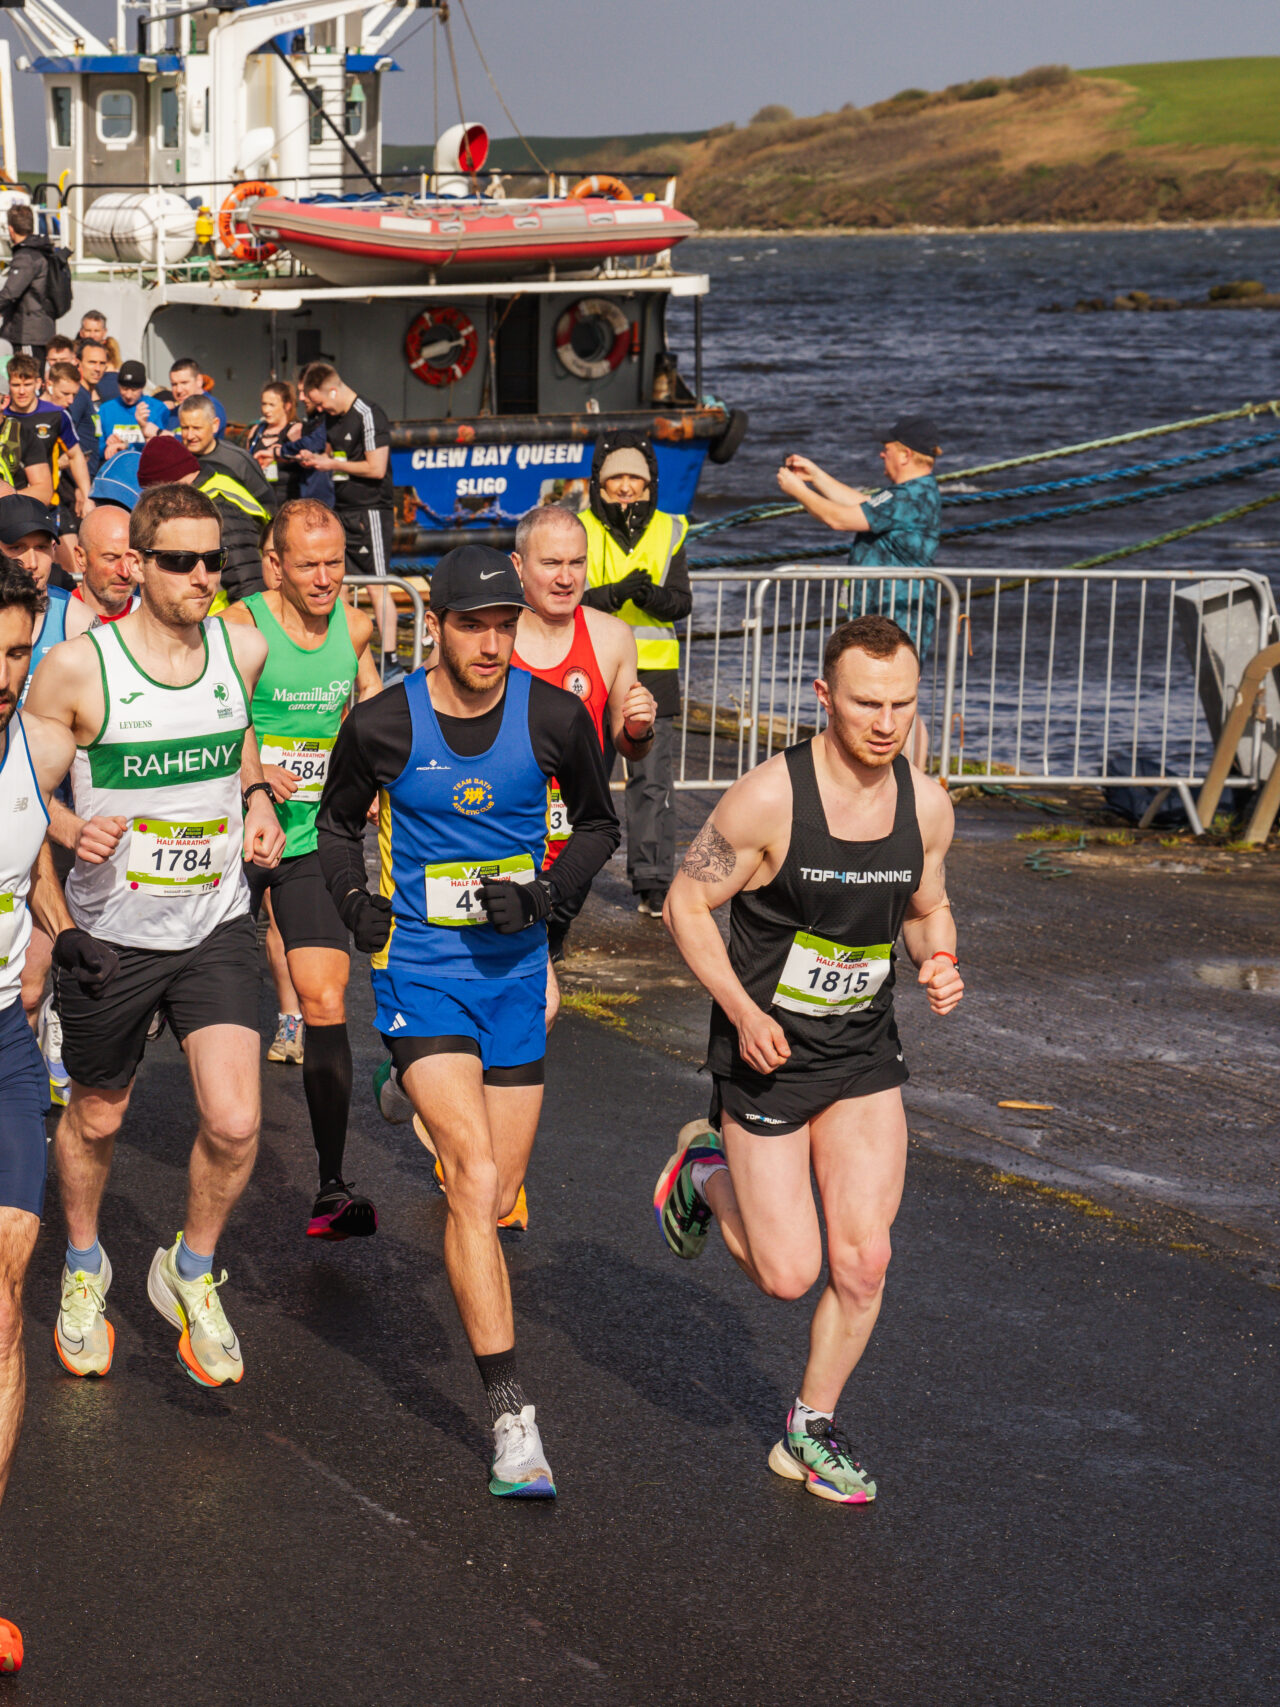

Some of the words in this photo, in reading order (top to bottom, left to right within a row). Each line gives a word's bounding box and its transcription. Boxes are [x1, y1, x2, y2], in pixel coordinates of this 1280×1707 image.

[411, 447, 468, 470] CLEW
[471, 445, 513, 467] BAY
[516, 443, 584, 470] QUEEN
[455, 477, 507, 496] SLIGO
[272, 688, 335, 701] Macmillan
[288, 703, 317, 711] cancer
[317, 701, 341, 714] relief
[120, 720, 152, 729] LEYDENS
[123, 743, 237, 777] RAHENY
[453, 778, 472, 791] TEAM
[474, 778, 492, 791] BATH
[452, 802, 480, 815] ATHLETIC
[480, 800, 495, 813] CLUB
[156, 838, 174, 846] HALF
[151, 848, 212, 871] 1784
[800, 867, 913, 883] TOP4RUNNING
[450, 879, 469, 887] HALF
[816, 956, 834, 967] HALF
[835, 961, 869, 970] MARATHON
[807, 967, 870, 995] 1815
